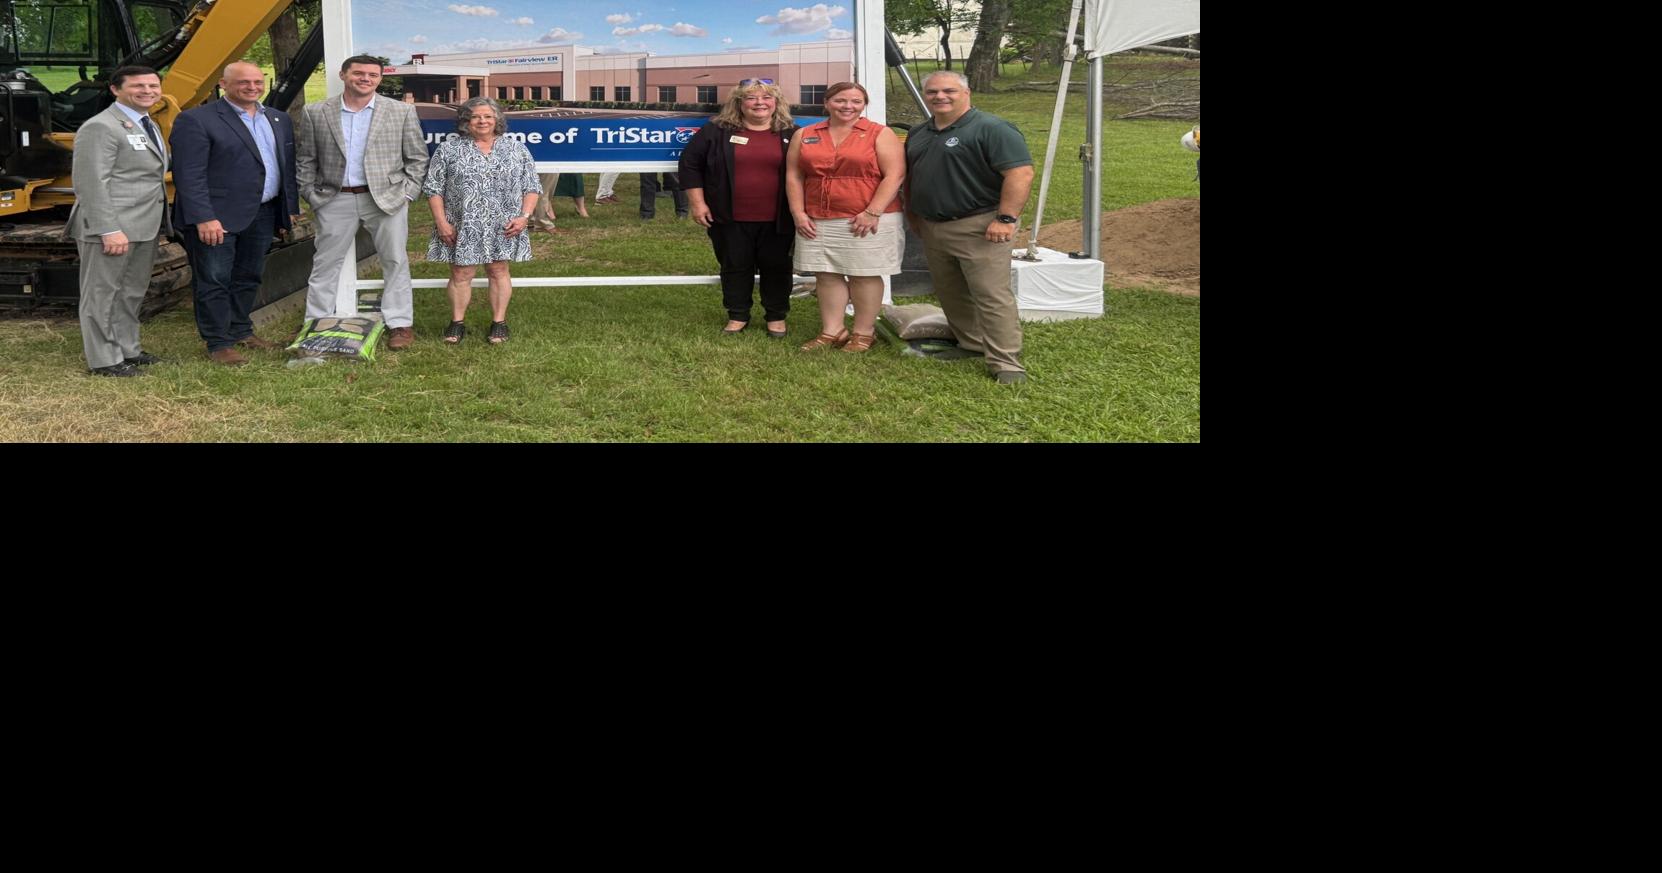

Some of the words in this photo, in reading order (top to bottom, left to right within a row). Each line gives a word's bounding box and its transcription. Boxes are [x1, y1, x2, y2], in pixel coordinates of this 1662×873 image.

[424, 132, 460, 144] ure
[503, 132, 542, 144] me
[549, 127, 578, 144] of
[590, 126, 676, 144] TriStar
